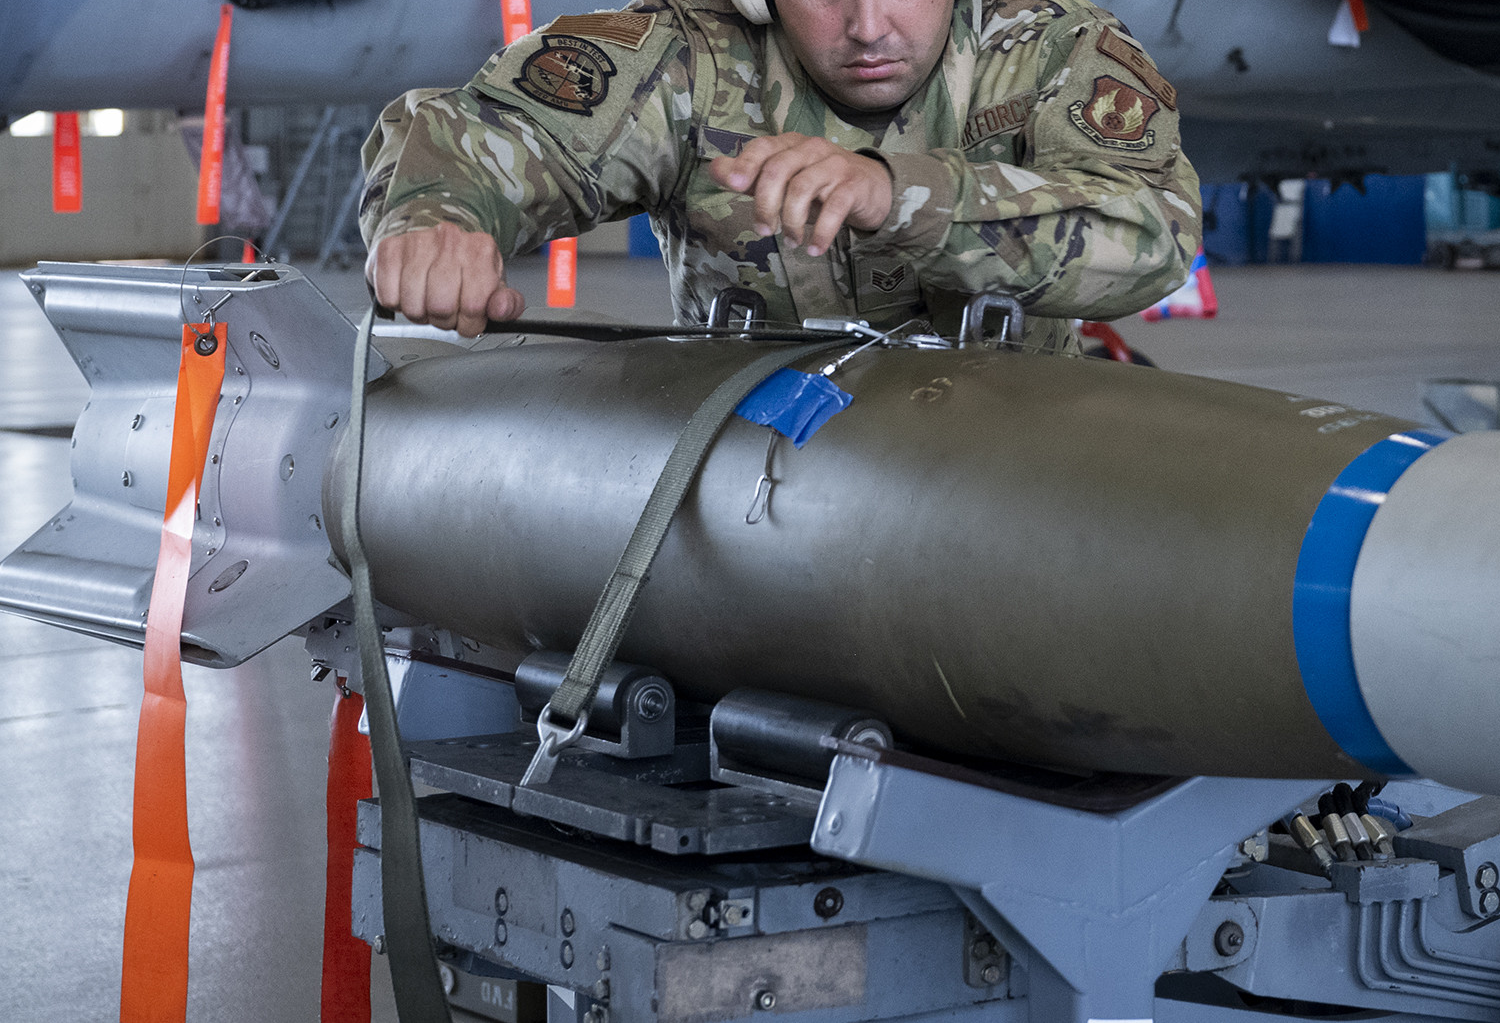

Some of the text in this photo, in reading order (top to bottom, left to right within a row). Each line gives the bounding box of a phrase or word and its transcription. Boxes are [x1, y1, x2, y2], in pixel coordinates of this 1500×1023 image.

[557, 38, 606, 63] BEST IN TEST
[974, 95, 1036, 138] FORCE
